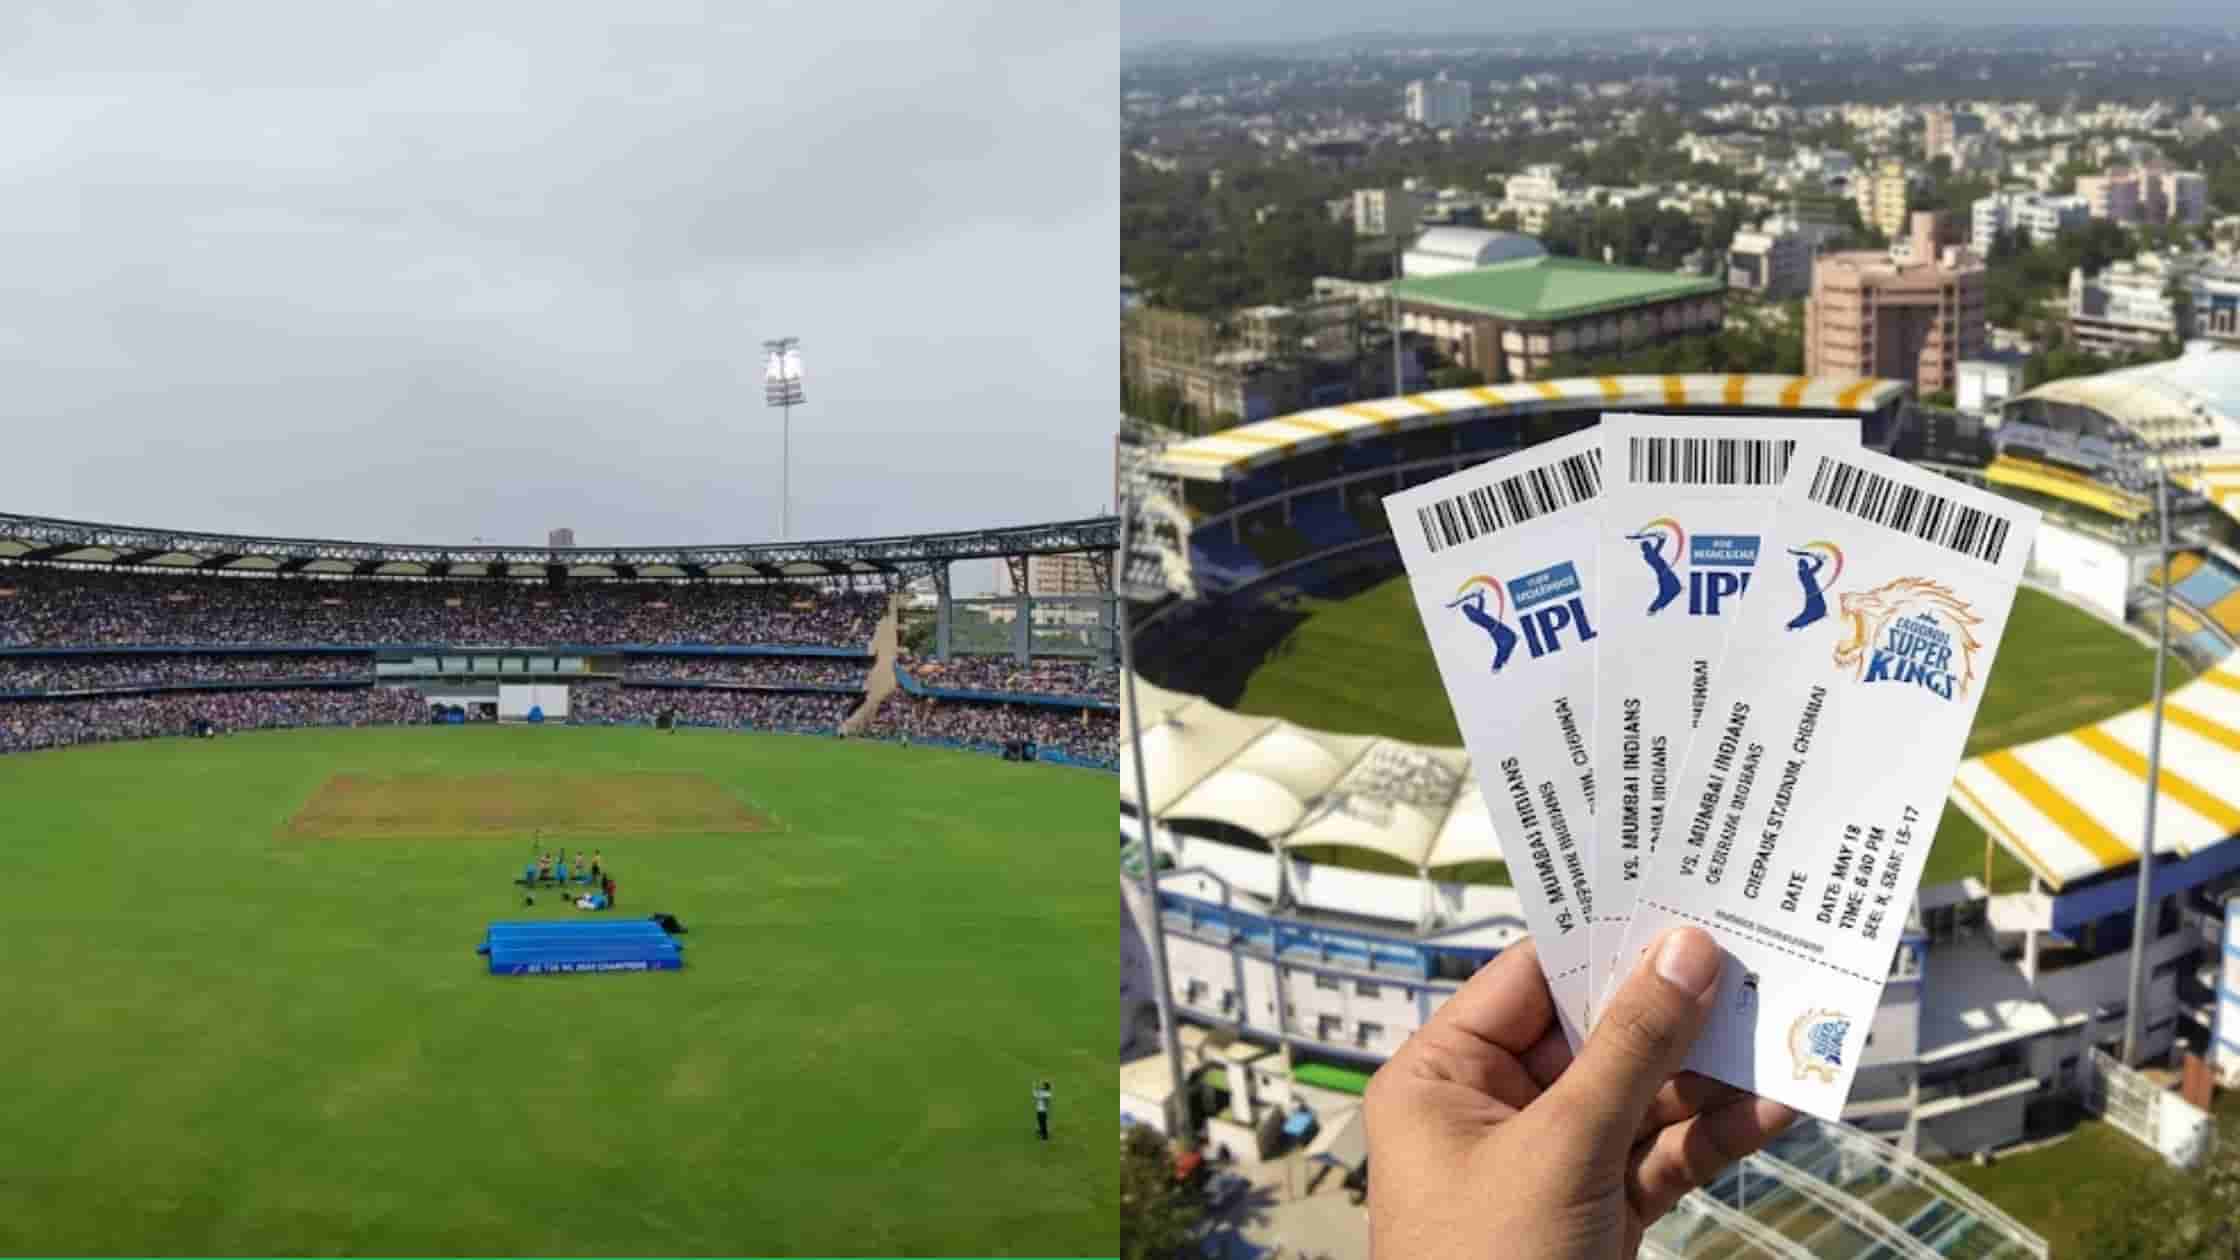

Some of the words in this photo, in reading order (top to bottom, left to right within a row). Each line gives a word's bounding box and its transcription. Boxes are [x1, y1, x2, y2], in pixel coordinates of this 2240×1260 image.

[1519, 597, 1598, 659] IPL
[1885, 627, 1953, 671] SUPER
[1863, 648, 1957, 701] KINGS
[1623, 698, 1641, 771] INDIANS
[1501, 756, 1539, 830] INDIANS
[1687, 773, 1725, 848] MUMBAI
[1712, 701, 1750, 772] INDIANS
[1622, 776, 1640, 850] MUMBAI
[1526, 831, 1566, 905] MUMBAI
[1780, 870, 1808, 912] DATE
[1831, 844, 1854, 880] MAY
